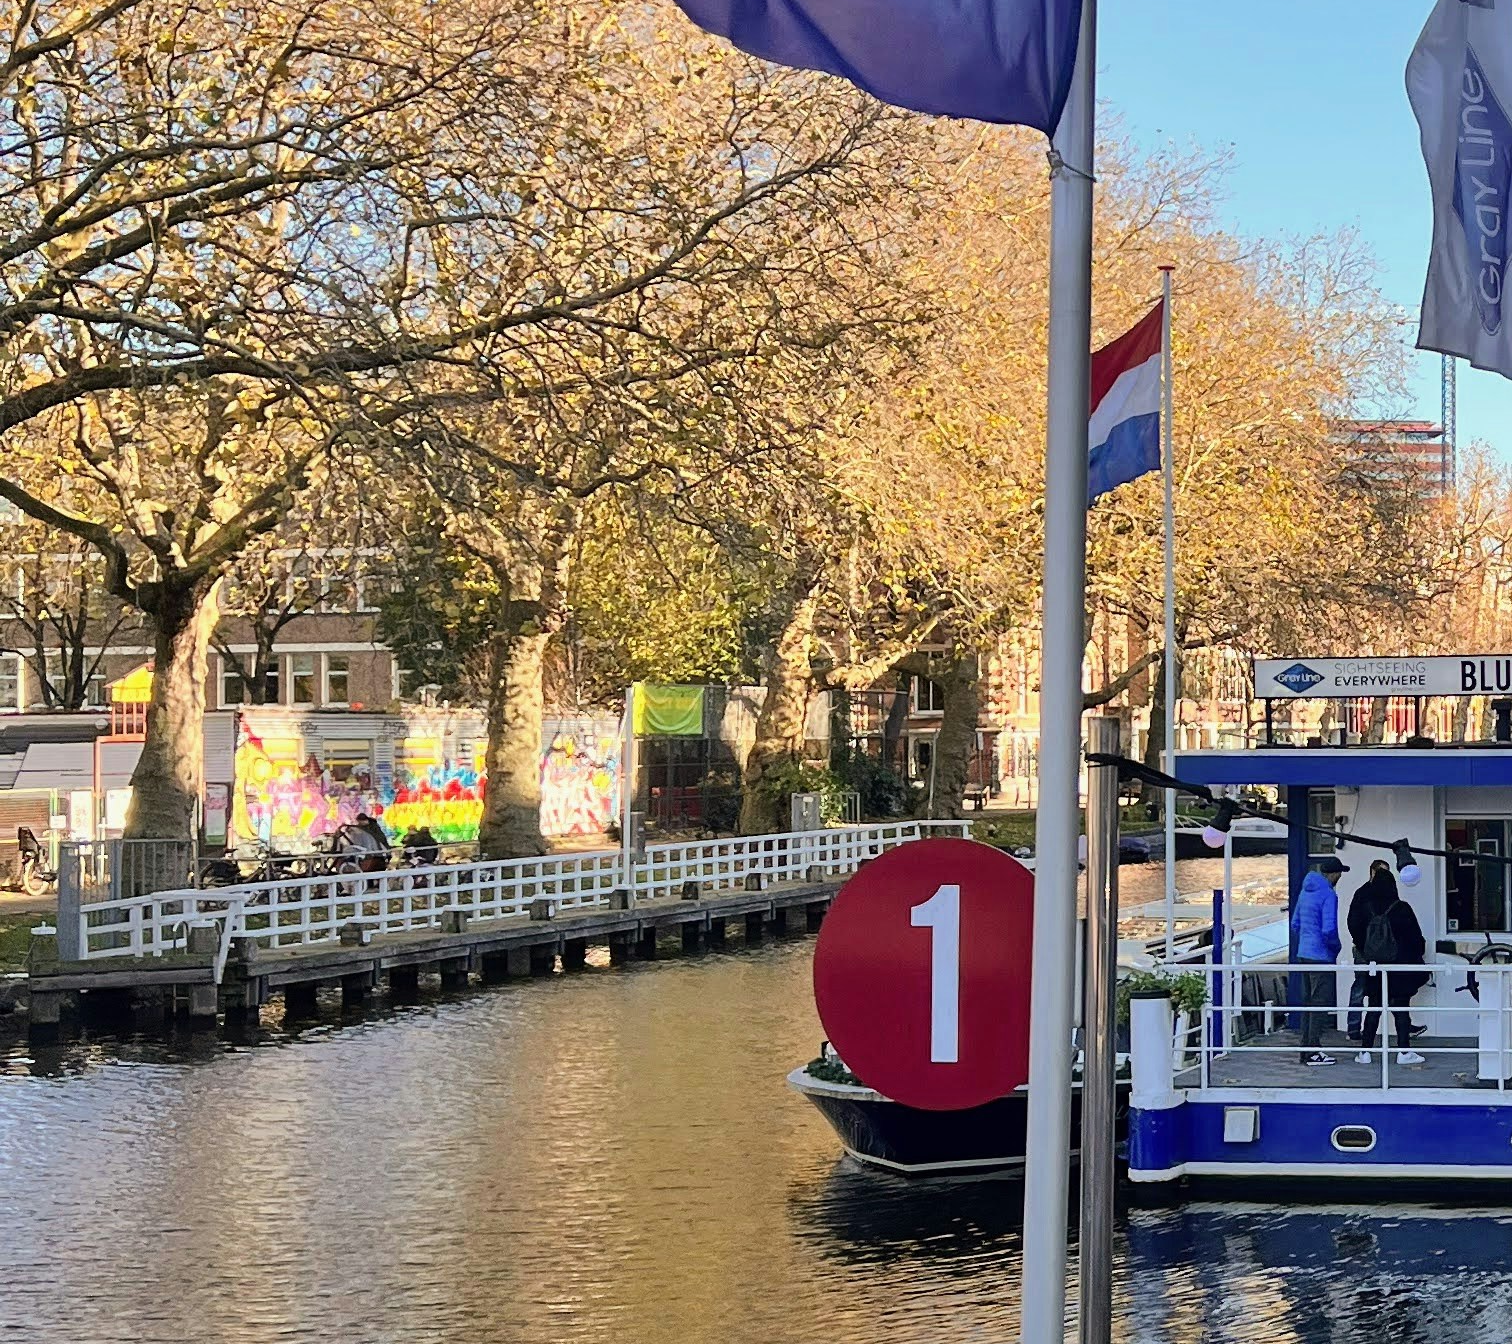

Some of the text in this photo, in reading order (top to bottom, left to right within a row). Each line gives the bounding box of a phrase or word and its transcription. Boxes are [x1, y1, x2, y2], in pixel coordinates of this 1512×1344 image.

[1458, 67, 1502, 305] Gray Line
[1334, 661, 1426, 674] SIGHTSEEING
[1334, 675, 1426, 686] EVERYWHERE
[911, 884, 960, 1063] 1
